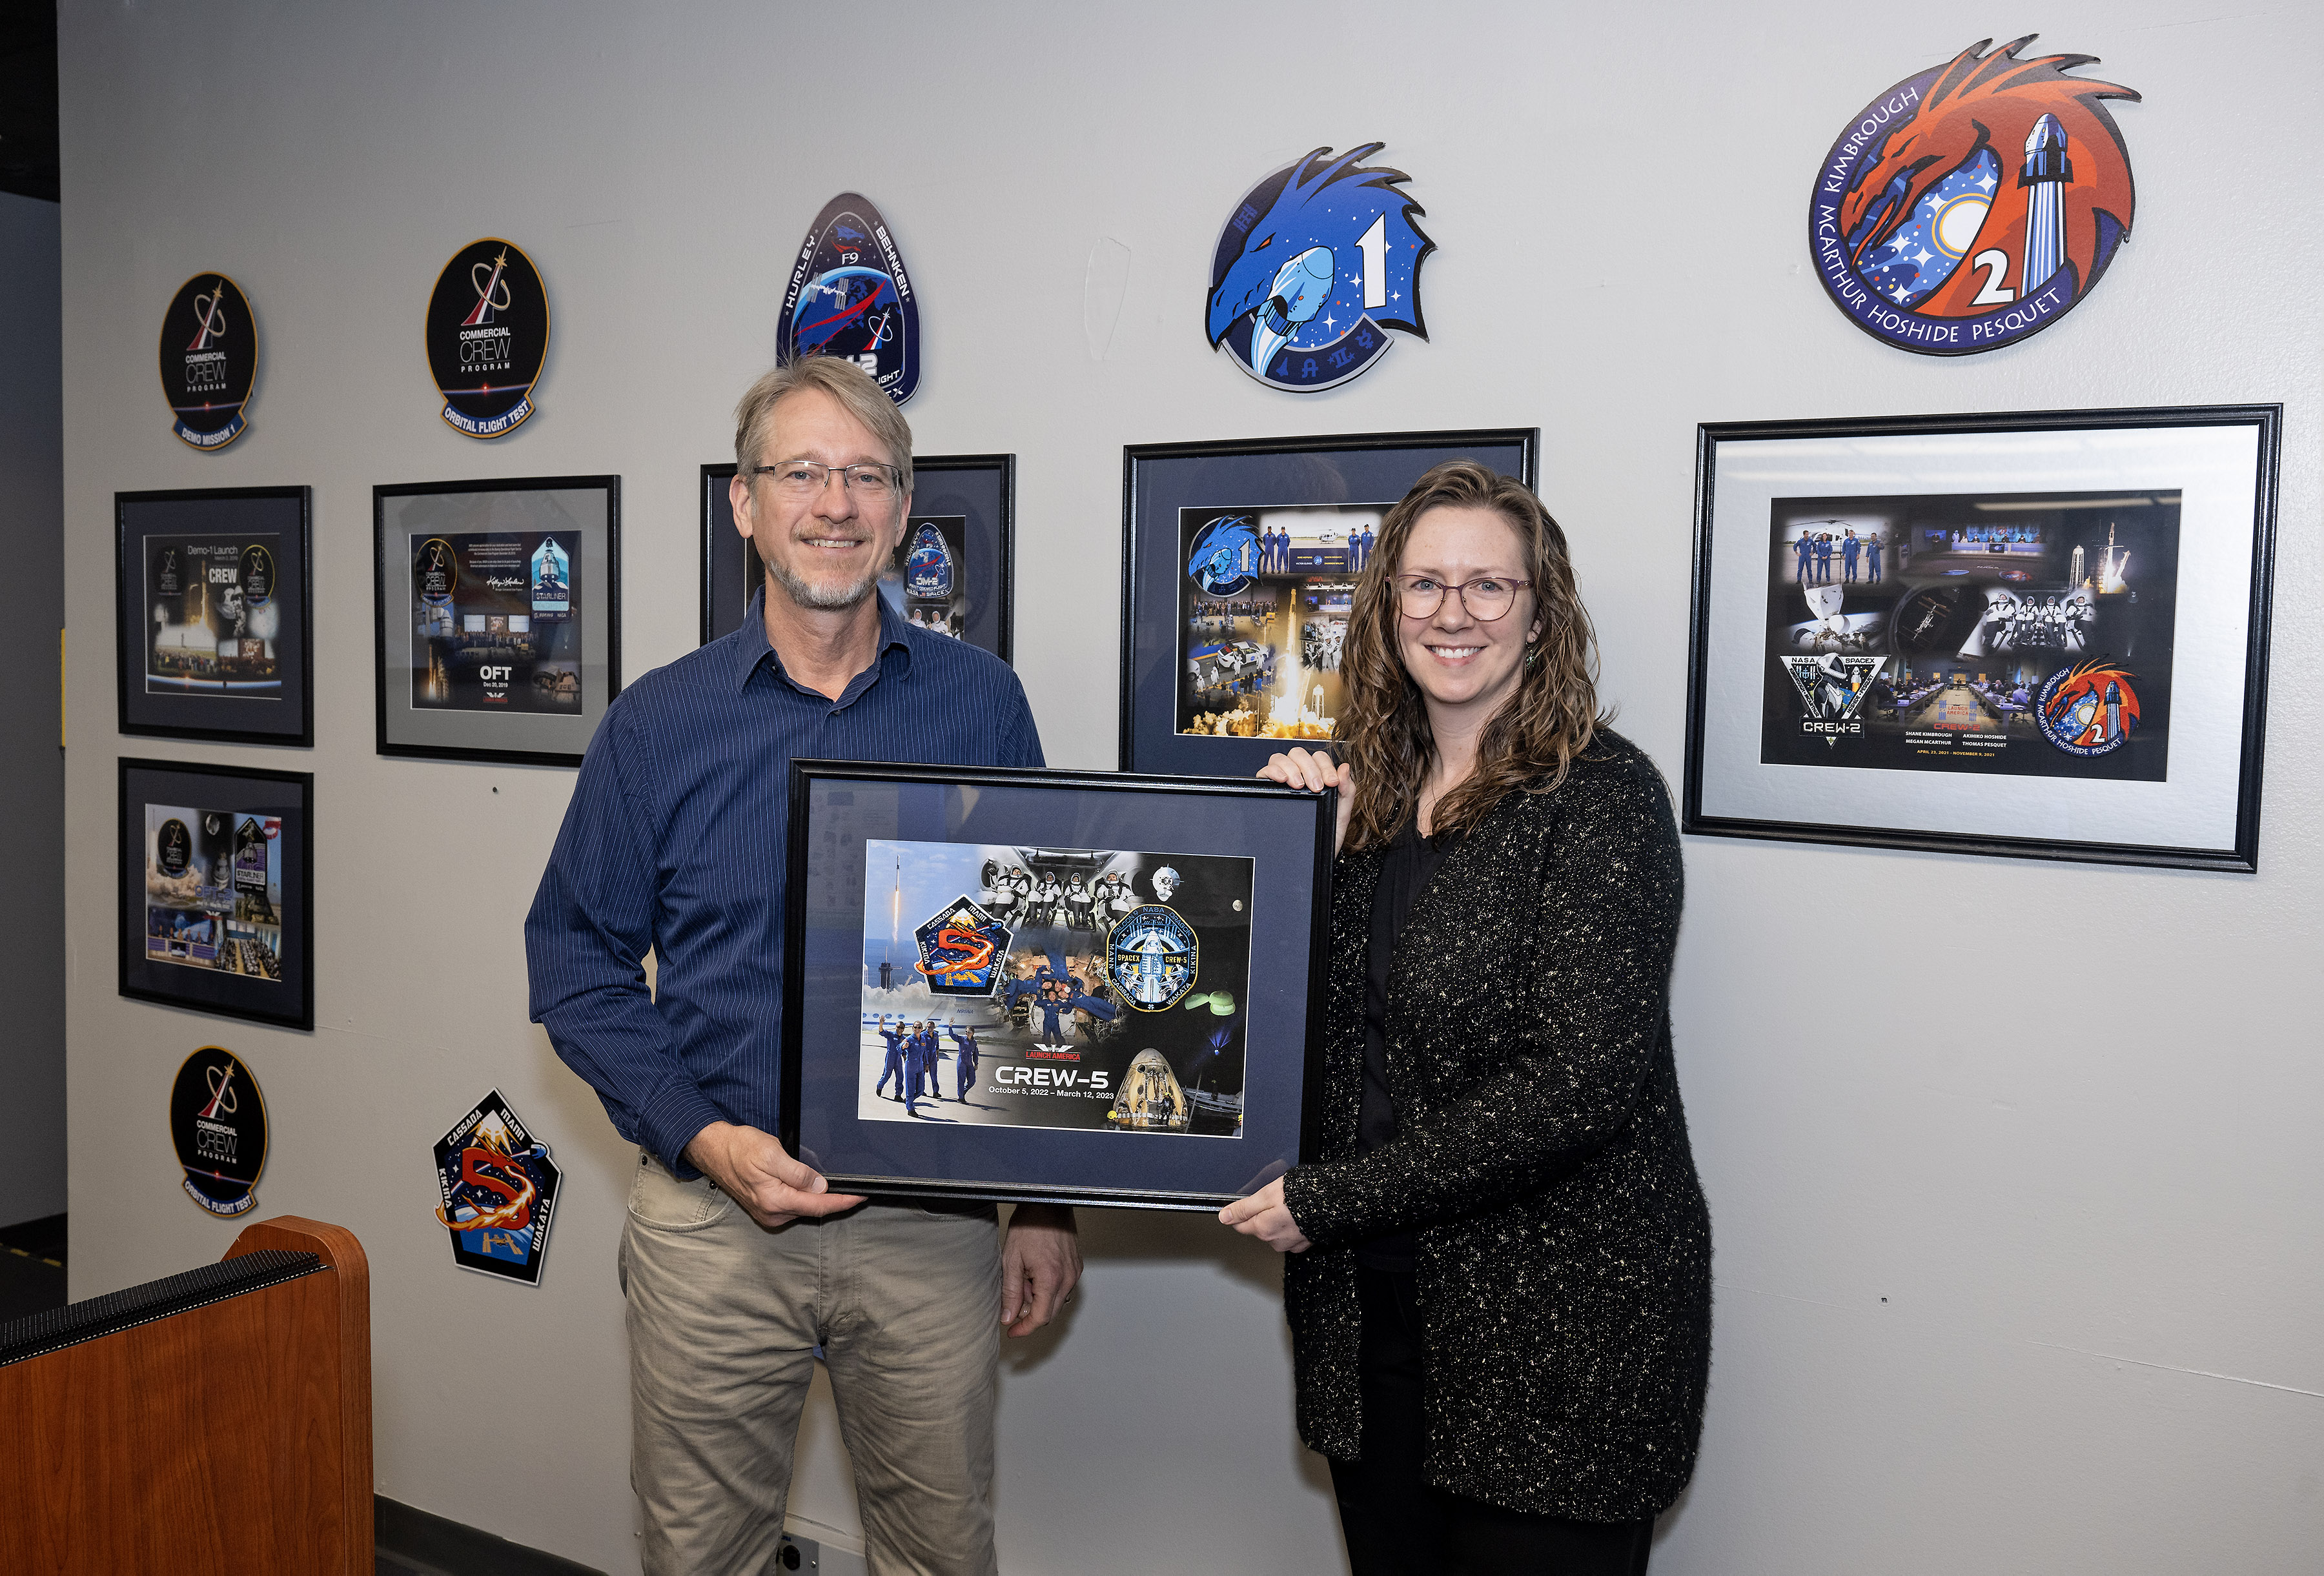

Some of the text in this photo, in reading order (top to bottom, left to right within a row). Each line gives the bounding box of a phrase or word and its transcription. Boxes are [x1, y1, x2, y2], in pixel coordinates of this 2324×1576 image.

[1824, 86, 1919, 193] KIMBROUGH
[842, 252, 859, 265] F9
[875, 225, 910, 297] BEHNKEN
[1354, 210, 1387, 309] 1
[786, 235, 815, 308] HURLEY
[1819, 204, 2060, 342] MCARTHUR HOSHIDE PESQUET
[1970, 248, 2015, 306] 2
[460, 327, 511, 340] COMMERCIAL
[185, 352, 226, 363] COMMERCIAL
[460, 338, 511, 363] CREW
[186, 361, 226, 384] CREW
[461, 362, 510, 372] PROGRAM
[187, 383, 226, 392] PROGRAM
[444, 400, 529, 433] ORBITAL FLIGHT TEST
[182, 424, 236, 445] DEMO MISSION 1
[906, 536, 918, 561] HURLEY
[1239, 540, 1249, 572] 1
[209, 568, 237, 583] CREW
[916, 577, 939, 585] DM-2
[907, 588, 919, 596] NASA
[480, 665, 512, 680] OFT
[2039, 668, 2070, 702] KIMBROUGH
[1803, 722, 1860, 733] CREW-2
[1934, 723, 1981, 731] CREW-2
[2037, 704, 2121, 754] MCARTHUR HOSHIDE PESQUET
[2090, 724, 2105, 742] 2
[195, 885, 232, 901] OFT-2
[927, 908, 955, 930] CASSADA
[1113, 915, 1134, 935] FALCON
[1169, 913, 1192, 936] DRAGON
[919, 941, 930, 964] KIKINA
[990, 950, 1004, 978] WAKATA
[1111, 979, 1136, 1005] CASSADA
[1167, 983, 1191, 1005] WAKATA
[1026, 1051, 1081, 1060] LAUNCH AMERICA
[995, 1066, 1108, 1089] CREW-5
[989, 1086, 1020, 1095] October
[197, 1120, 237, 1137] COMMERCIAL
[447, 1109, 482, 1146] CASSADA
[500, 1108, 525, 1141] MANN
[197, 1129, 237, 1155] CREW
[198, 1149, 237, 1164] PROGRAM
[185, 1181, 251, 1213] ORBITAL FLIGHT TEST
[438, 1167, 453, 1209] KIKINA
[532, 1198, 550, 1251] WAKATA
